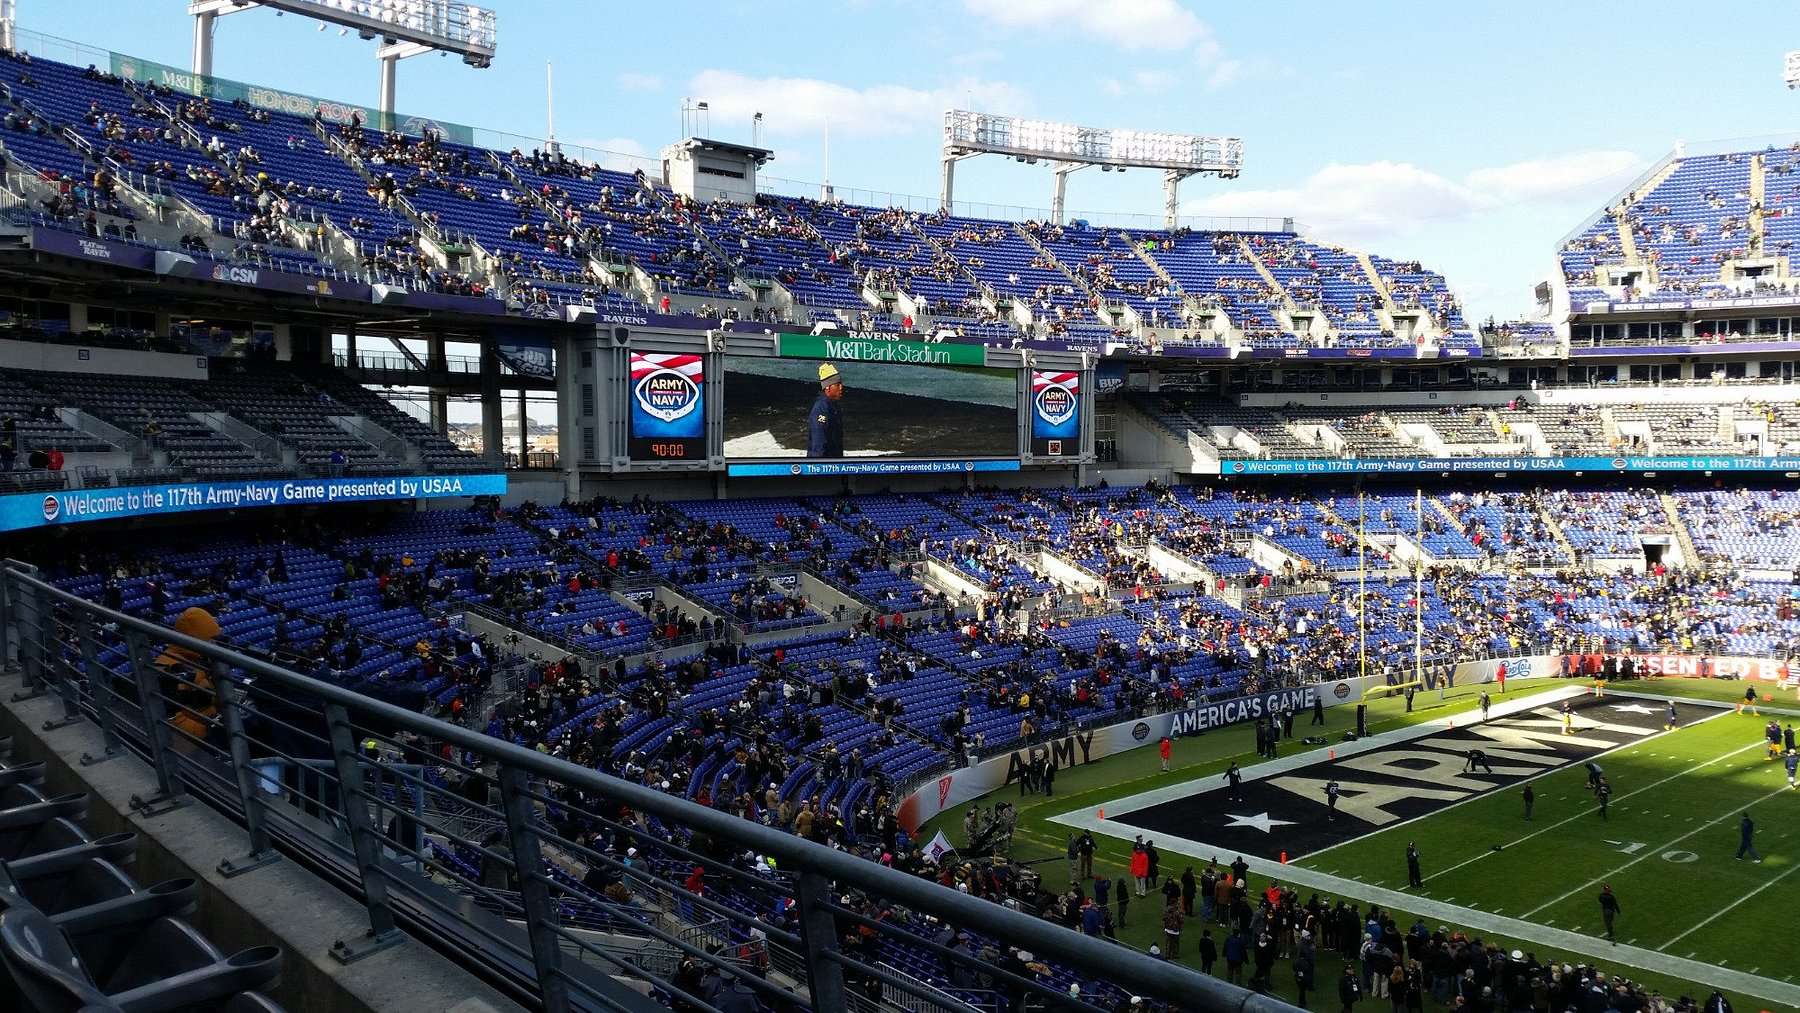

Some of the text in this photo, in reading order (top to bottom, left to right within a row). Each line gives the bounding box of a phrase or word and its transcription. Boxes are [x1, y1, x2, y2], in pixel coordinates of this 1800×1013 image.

[248, 86, 314, 117] HONOR
[230, 267, 258, 284] CSN
[602, 314, 648, 325] RAVENS
[848, 330, 900, 342] RAVENS
[825, 339, 950, 364] M&T Bank Stadium
[1066, 345, 1098, 353] RAVENS
[651, 379, 684, 389] ARMY
[652, 395, 684, 406] NAVY
[1045, 391, 1066, 401] ARMY
[1046, 404, 1066, 413] NAVY
[652, 444, 684, 456] 90:00
[807, 462, 960, 474] The 117th Army-Navy Game presented by USAA
[1248, 459, 1566, 472] Welcome to the 117th Army-Navy Game presented by USAA
[1631, 458, 1800, 469] Welcome to the 117th Arm
[64, 495, 124, 515] Welcome
[127, 492, 138, 510] to
[143, 490, 163, 508] the
[168, 487, 202, 506] 117th
[206, 484, 278, 506] Army-Navy
[283, 483, 324, 500] Game
[329, 480, 396, 500] presented
[401, 479, 418, 497] by
[422, 478, 463, 493] USAA
[1386, 664, 1458, 697] NAVY
[1170, 698, 1262, 736] AMERICA'S
[1267, 687, 1315, 713] GAME
[1005, 730, 1094, 785] ARMY
[1265, 706, 1660, 826] ARMY
